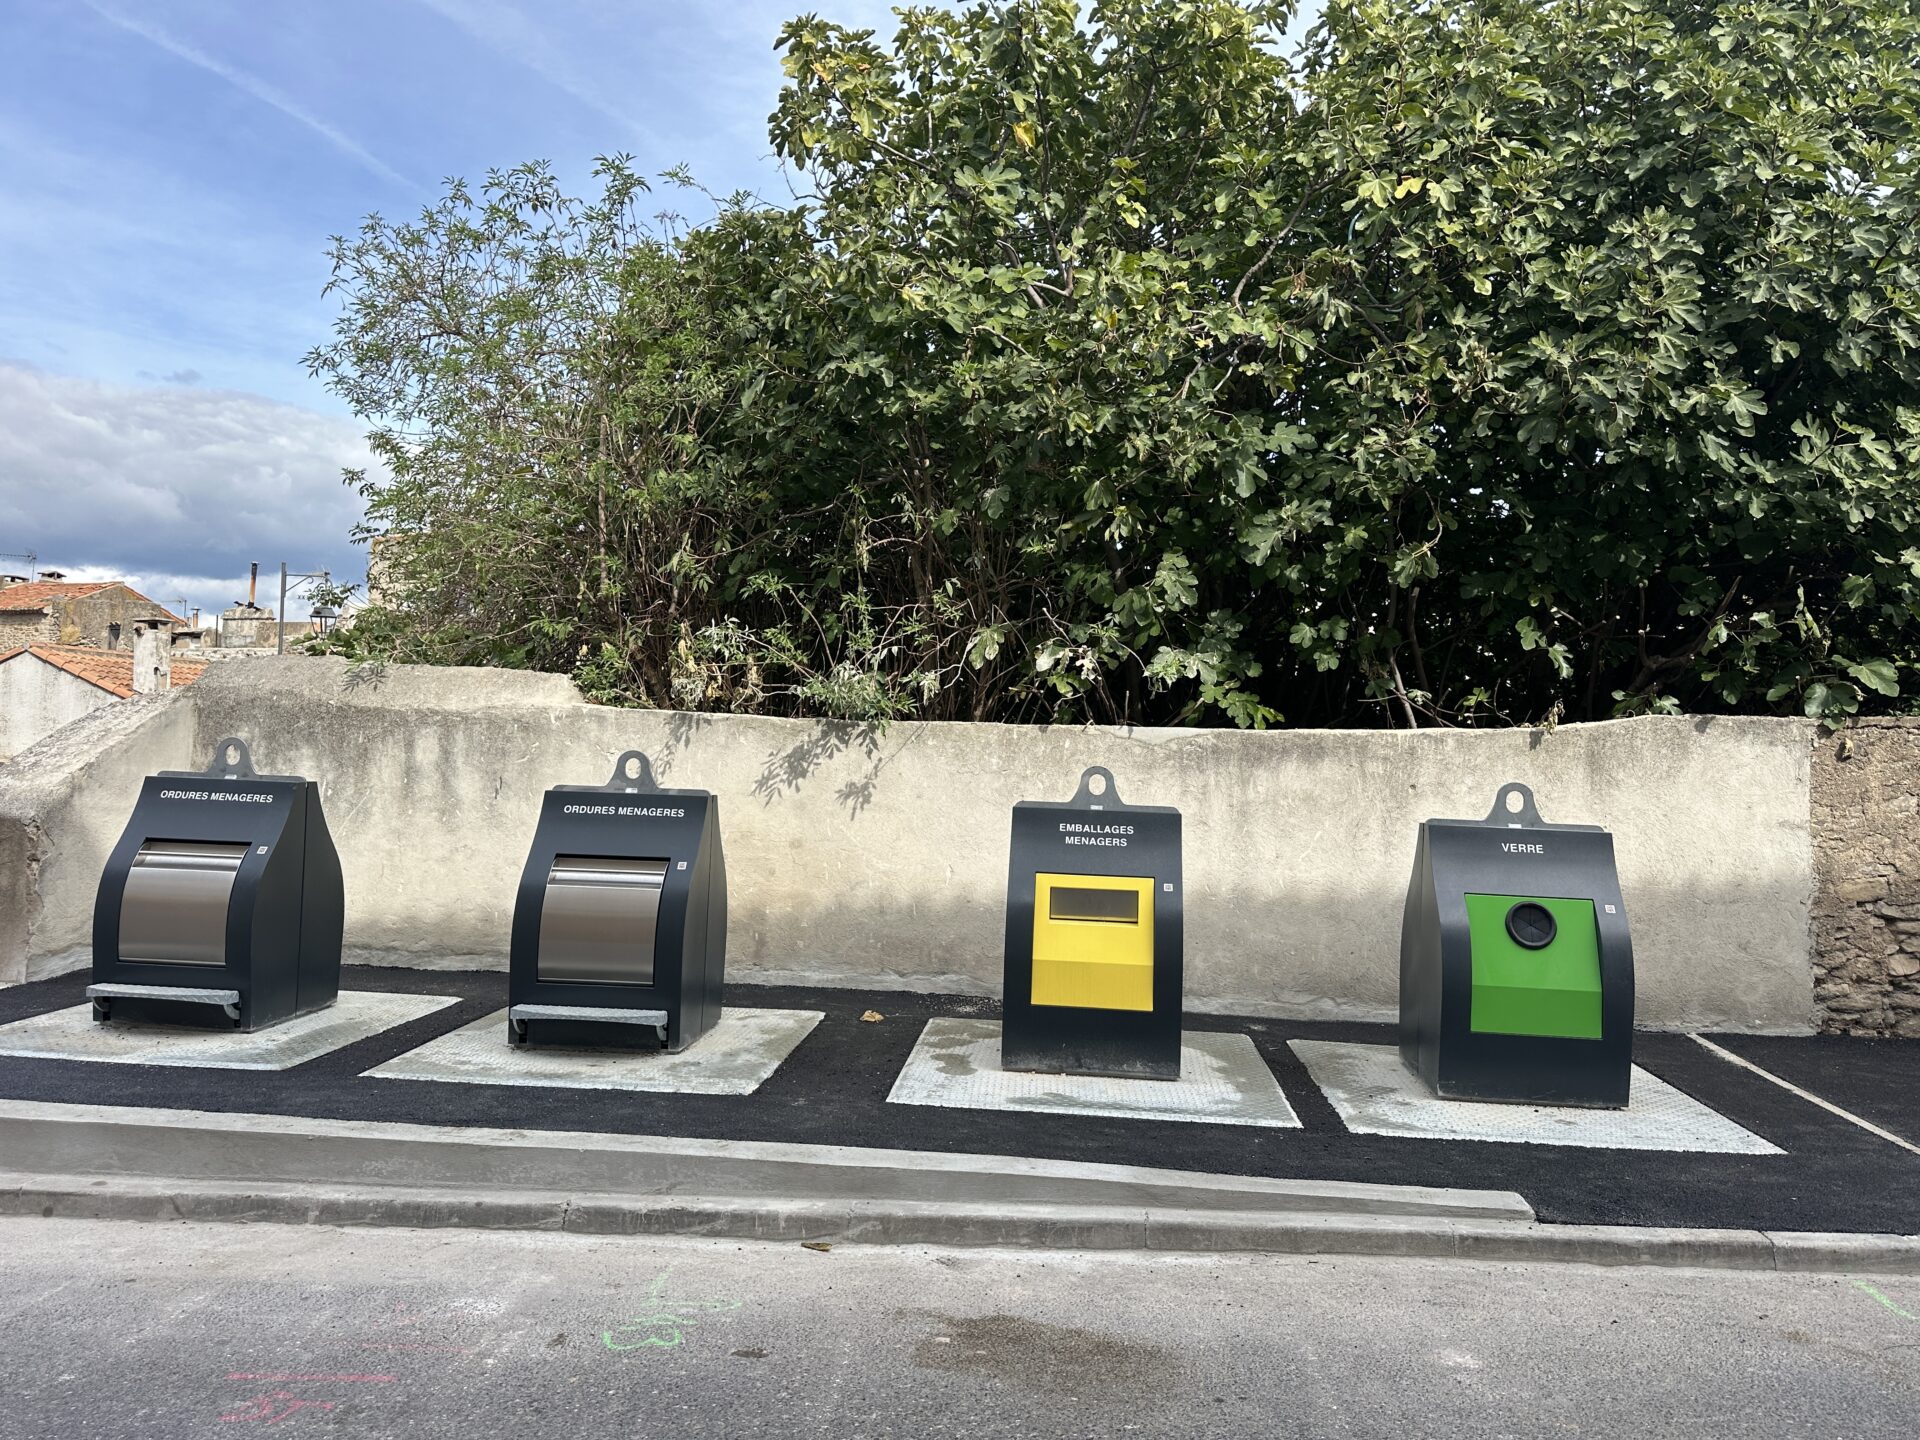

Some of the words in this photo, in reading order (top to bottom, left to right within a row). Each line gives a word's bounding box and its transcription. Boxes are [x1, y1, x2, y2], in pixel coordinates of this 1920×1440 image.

[160, 789, 209, 800] ORDURES
[210, 792, 274, 803] MENAGERES
[563, 804, 616, 815] ORDURES
[618, 806, 685, 817] MENAGERES
[1059, 823, 1134, 834] EMBALLAGES
[1065, 836, 1128, 847] MENAGERS
[1501, 842, 1544, 854] VERRE
